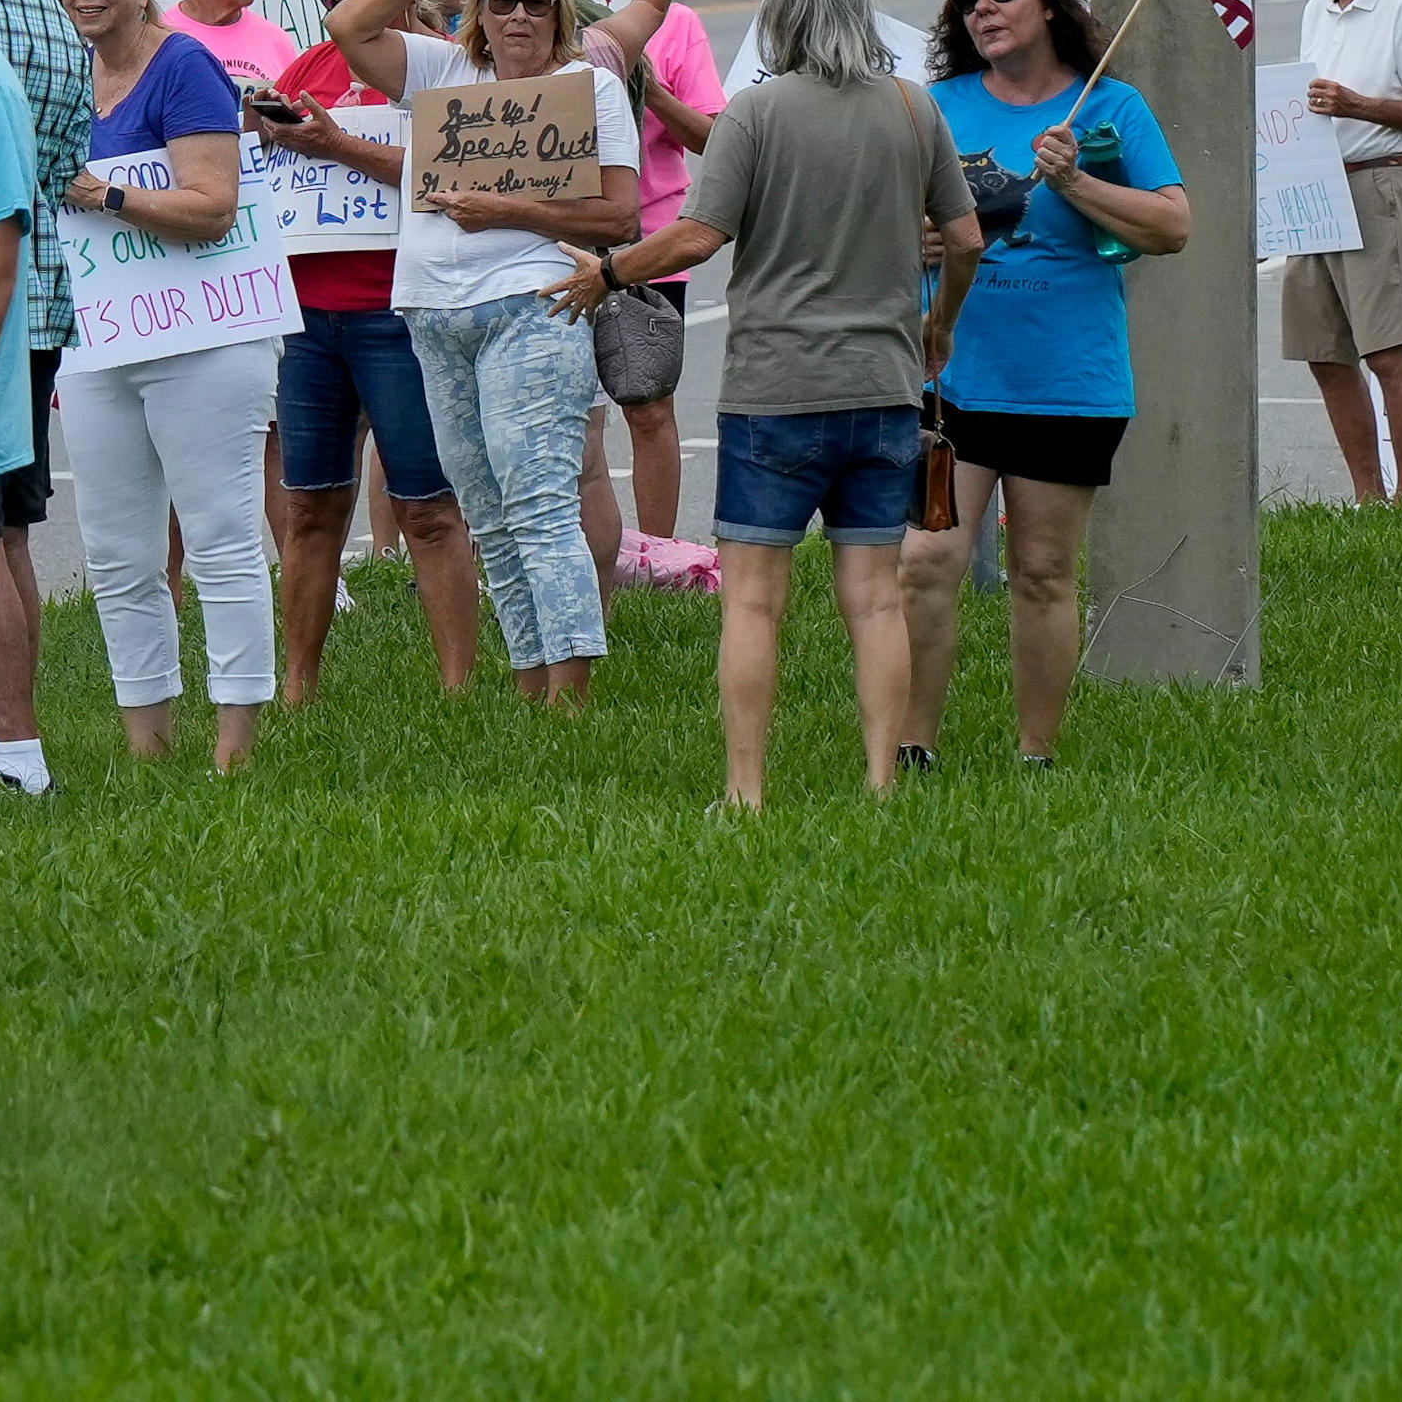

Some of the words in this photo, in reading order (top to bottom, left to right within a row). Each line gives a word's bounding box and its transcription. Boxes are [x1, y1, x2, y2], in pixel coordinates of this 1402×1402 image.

[501, 93, 542, 127] Up!
[433, 128, 529, 167] Speak
[537, 123, 598, 161] Out!
[291, 164, 338, 190] NOT
[317, 188, 388, 226] List
[1277, 179, 1333, 227] HEALTH
[112, 231, 166, 264] OUR
[986, 271, 1049, 292] America
[131, 288, 194, 337] OUR
[201, 264, 284, 322] DUTY
